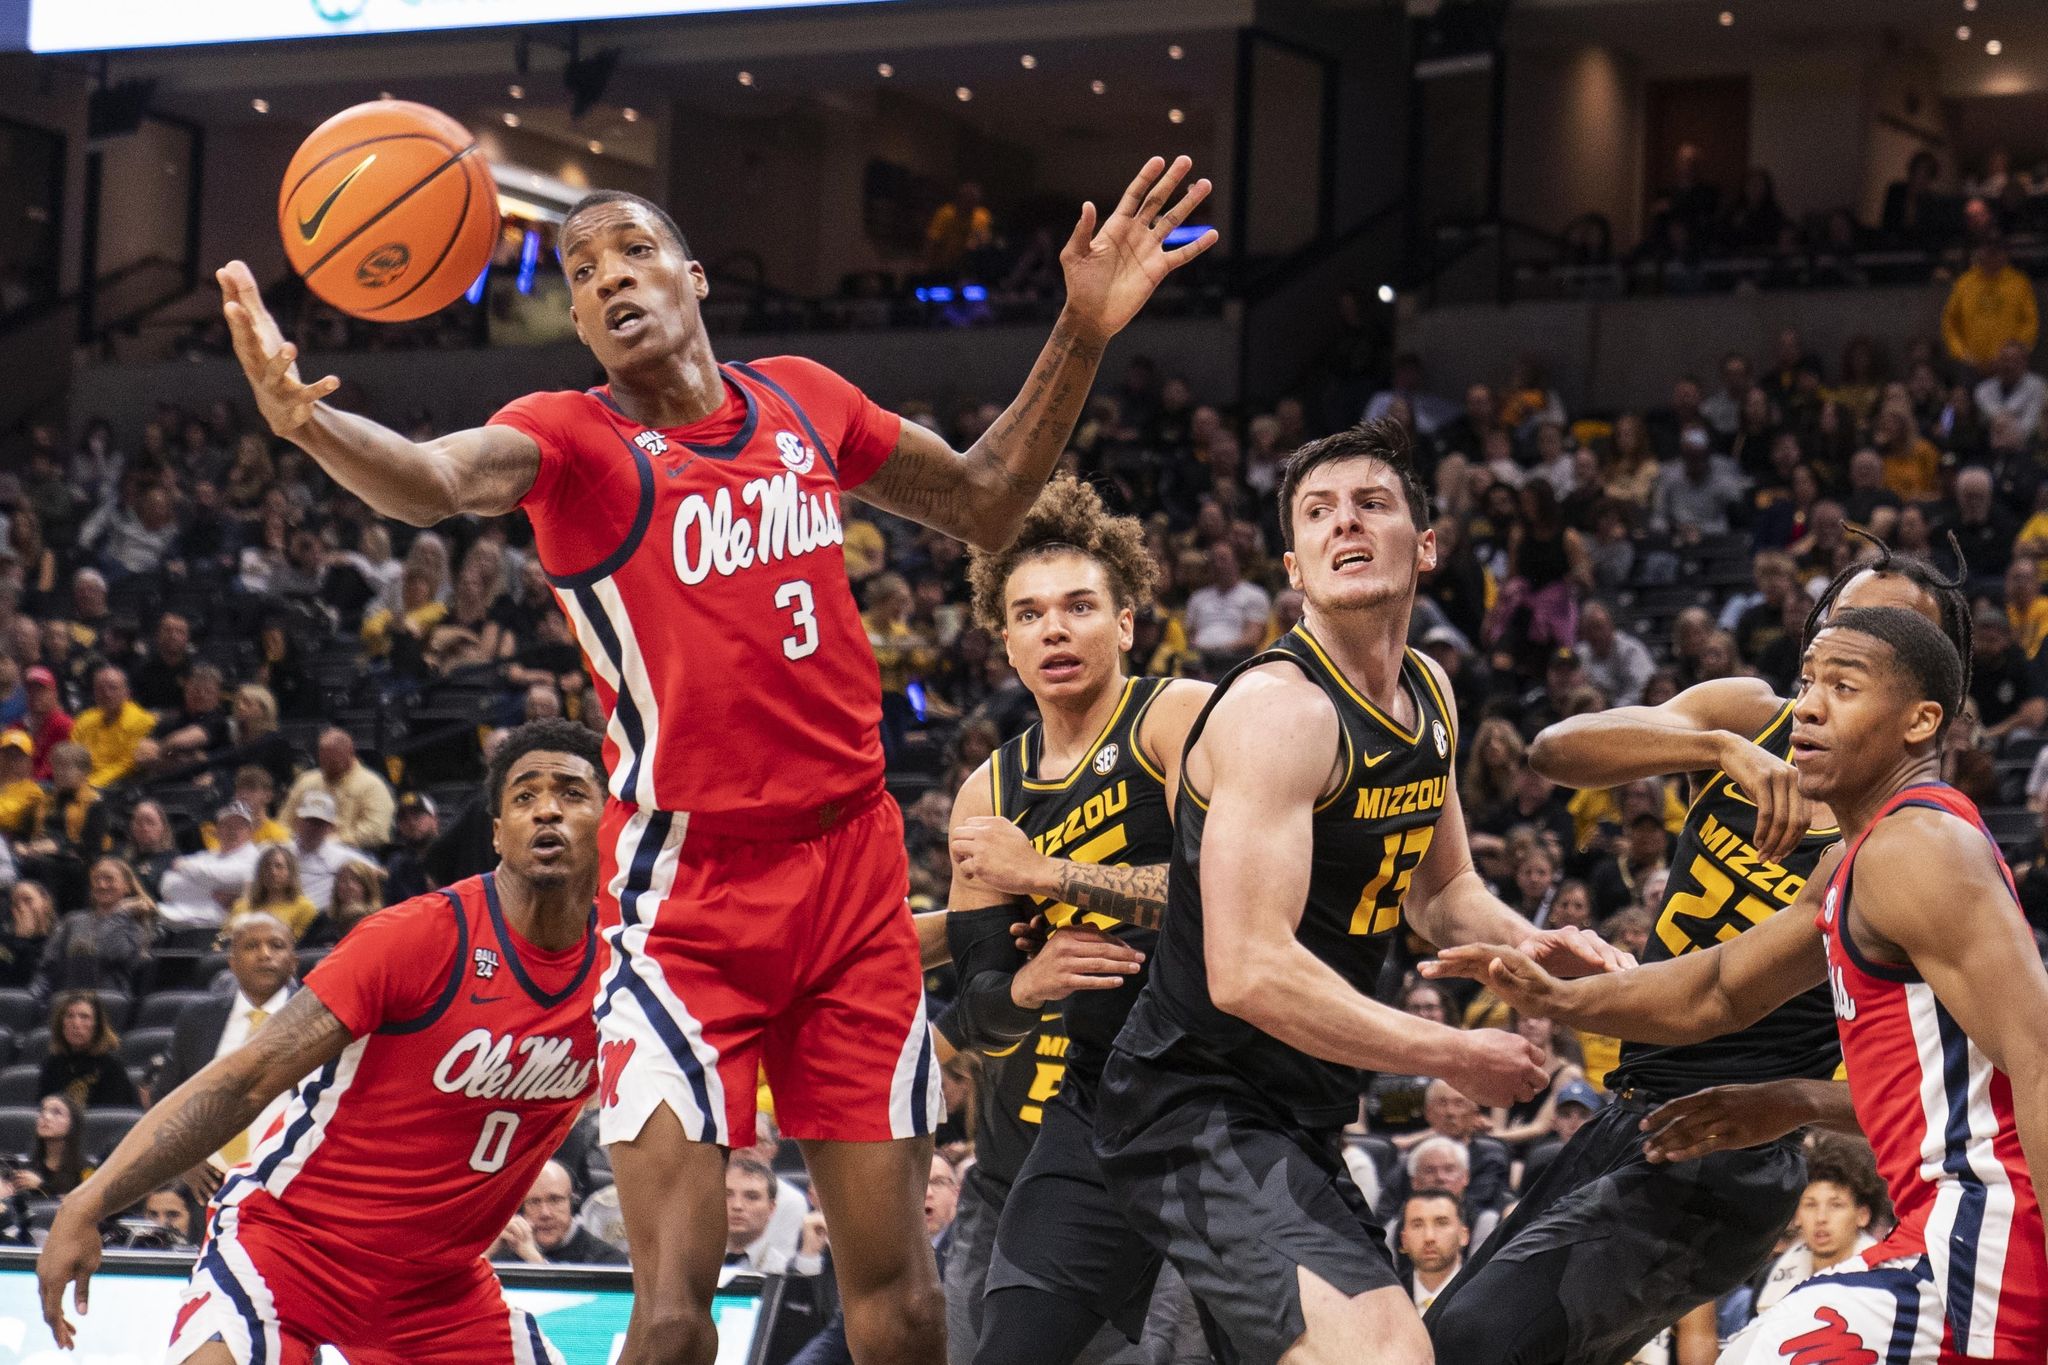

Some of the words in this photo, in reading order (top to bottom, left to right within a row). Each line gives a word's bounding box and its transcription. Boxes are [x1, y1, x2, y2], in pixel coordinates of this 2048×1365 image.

[634, 430, 666, 449] BALL
[646, 439, 669, 456] 24
[673, 487, 755, 585] Ole
[742, 471, 844, 564] Miss
[774, 580, 820, 661] 3
[1094, 742, 1118, 774] SEC
[1030, 780, 1128, 857] IZZOU
[1353, 775, 1447, 819] MIZZOU
[475, 948, 499, 967] BALL
[476, 961, 493, 978] 24
[433, 1028, 513, 1099] Ole
[501, 1036, 595, 1100] Miss
[468, 1110, 521, 1174] 0
